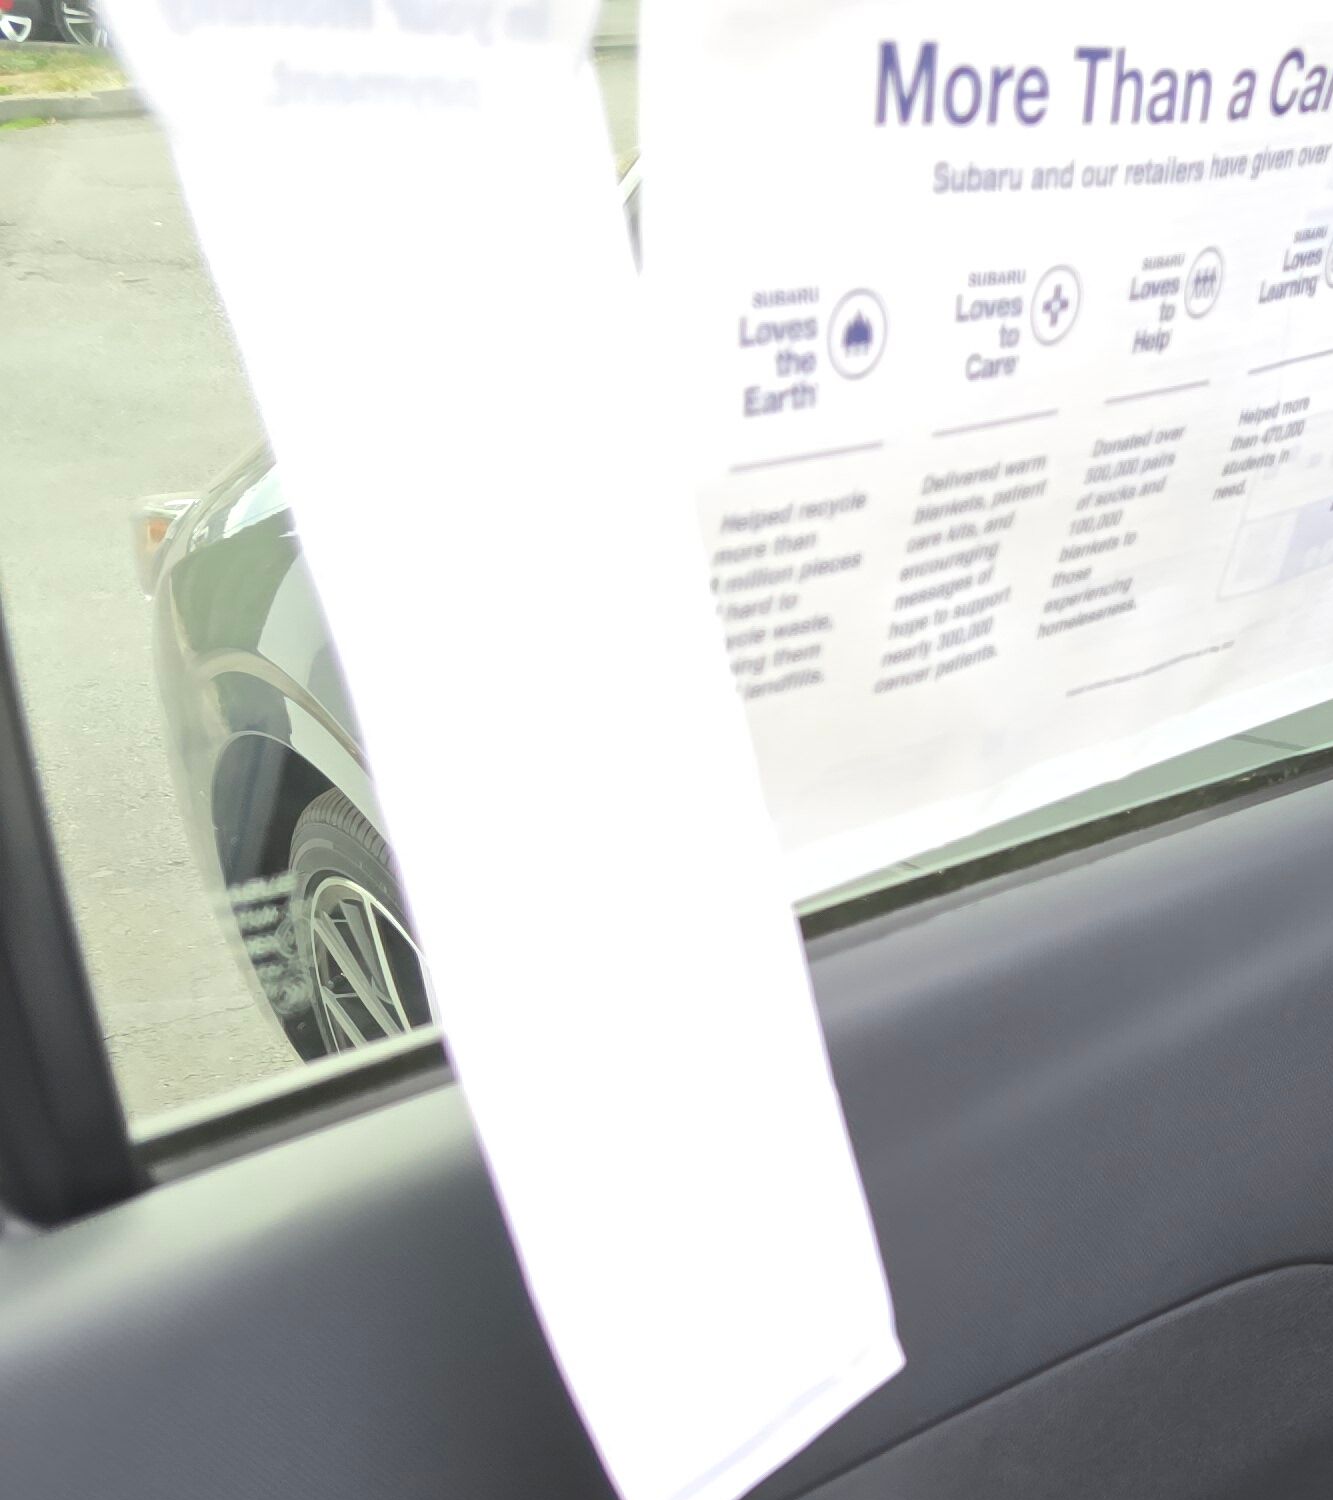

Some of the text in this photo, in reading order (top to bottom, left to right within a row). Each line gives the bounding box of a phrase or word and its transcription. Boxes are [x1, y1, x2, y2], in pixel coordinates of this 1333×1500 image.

[873, 39, 1051, 128] More
[1074, 46, 1213, 125] Than
[1227, 68, 1257, 121] a
[932, 160, 1023, 195] Subaru
[1030, 159, 1073, 191] and
[1082, 164, 1119, 188] our
[1124, 155, 1204, 186] retailers
[1209, 152, 1247, 180] have
[1250, 146, 1294, 179] given
[1297, 144, 1331, 167] over
[1293, 225, 1328, 244] SUBARU
[1142, 253, 1185, 271] SUBARU
[1282, 247, 1322, 272] Loves
[968, 269, 1026, 287] SUBARU
[1129, 276, 1180, 301] Loves
[1258, 273, 1320, 304] Learning
[752, 286, 819, 309] SUBARU
[955, 294, 1023, 322] Loves
[1159, 300, 1175, 323] to
[739, 316, 818, 348] Loves
[999, 324, 1020, 348] to
[1132, 328, 1172, 354] Help
[775, 350, 817, 378] the
[965, 353, 1019, 382] Care
[743, 383, 818, 418] Earth
